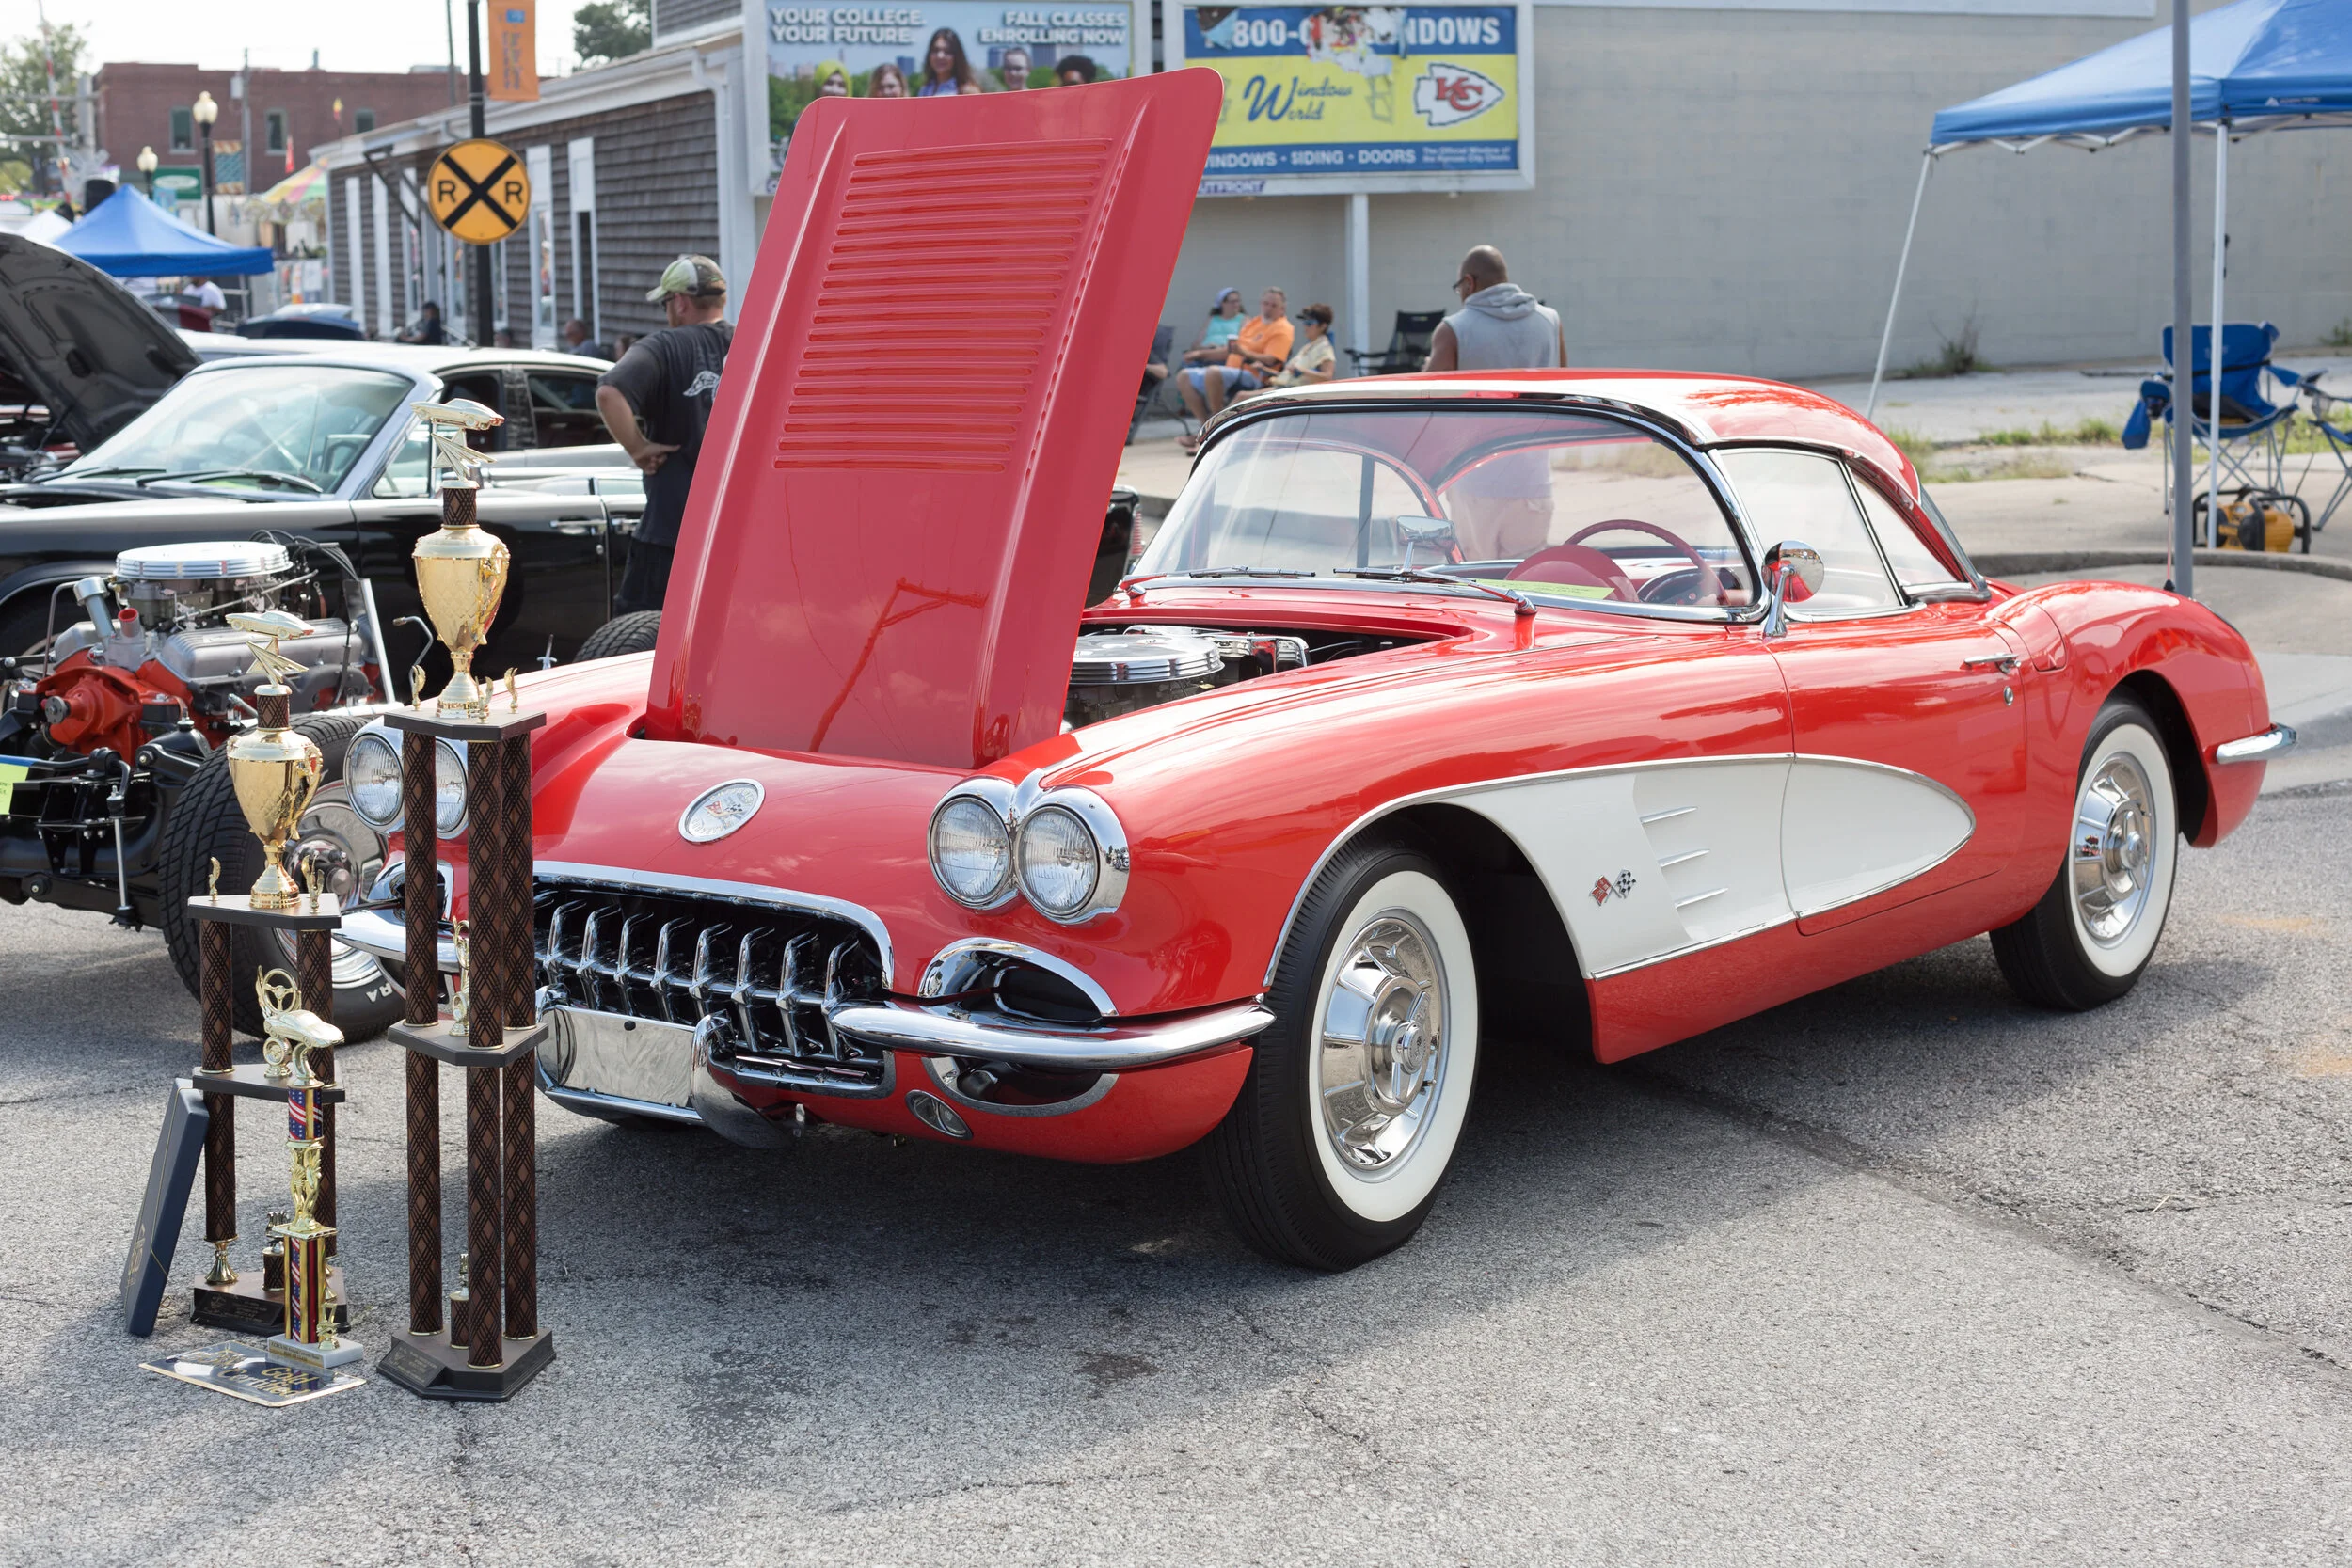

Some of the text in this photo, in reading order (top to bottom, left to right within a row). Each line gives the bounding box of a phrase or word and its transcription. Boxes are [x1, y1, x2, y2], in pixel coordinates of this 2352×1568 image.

[771, 8, 928, 25] YOUR COLLEGE.
[1004, 11, 1126, 26] FALL CLASSES
[771, 26, 917, 43] YOUR FUTURE.
[979, 29, 1126, 44] ENROLLING NOW
[1436, 76, 1484, 112] KC
[1291, 150, 1344, 166] SIDING
[1358, 148, 1416, 164] DOORS
[438, 181, 523, 204] R R
[261, 1367, 320, 1388] Gold
